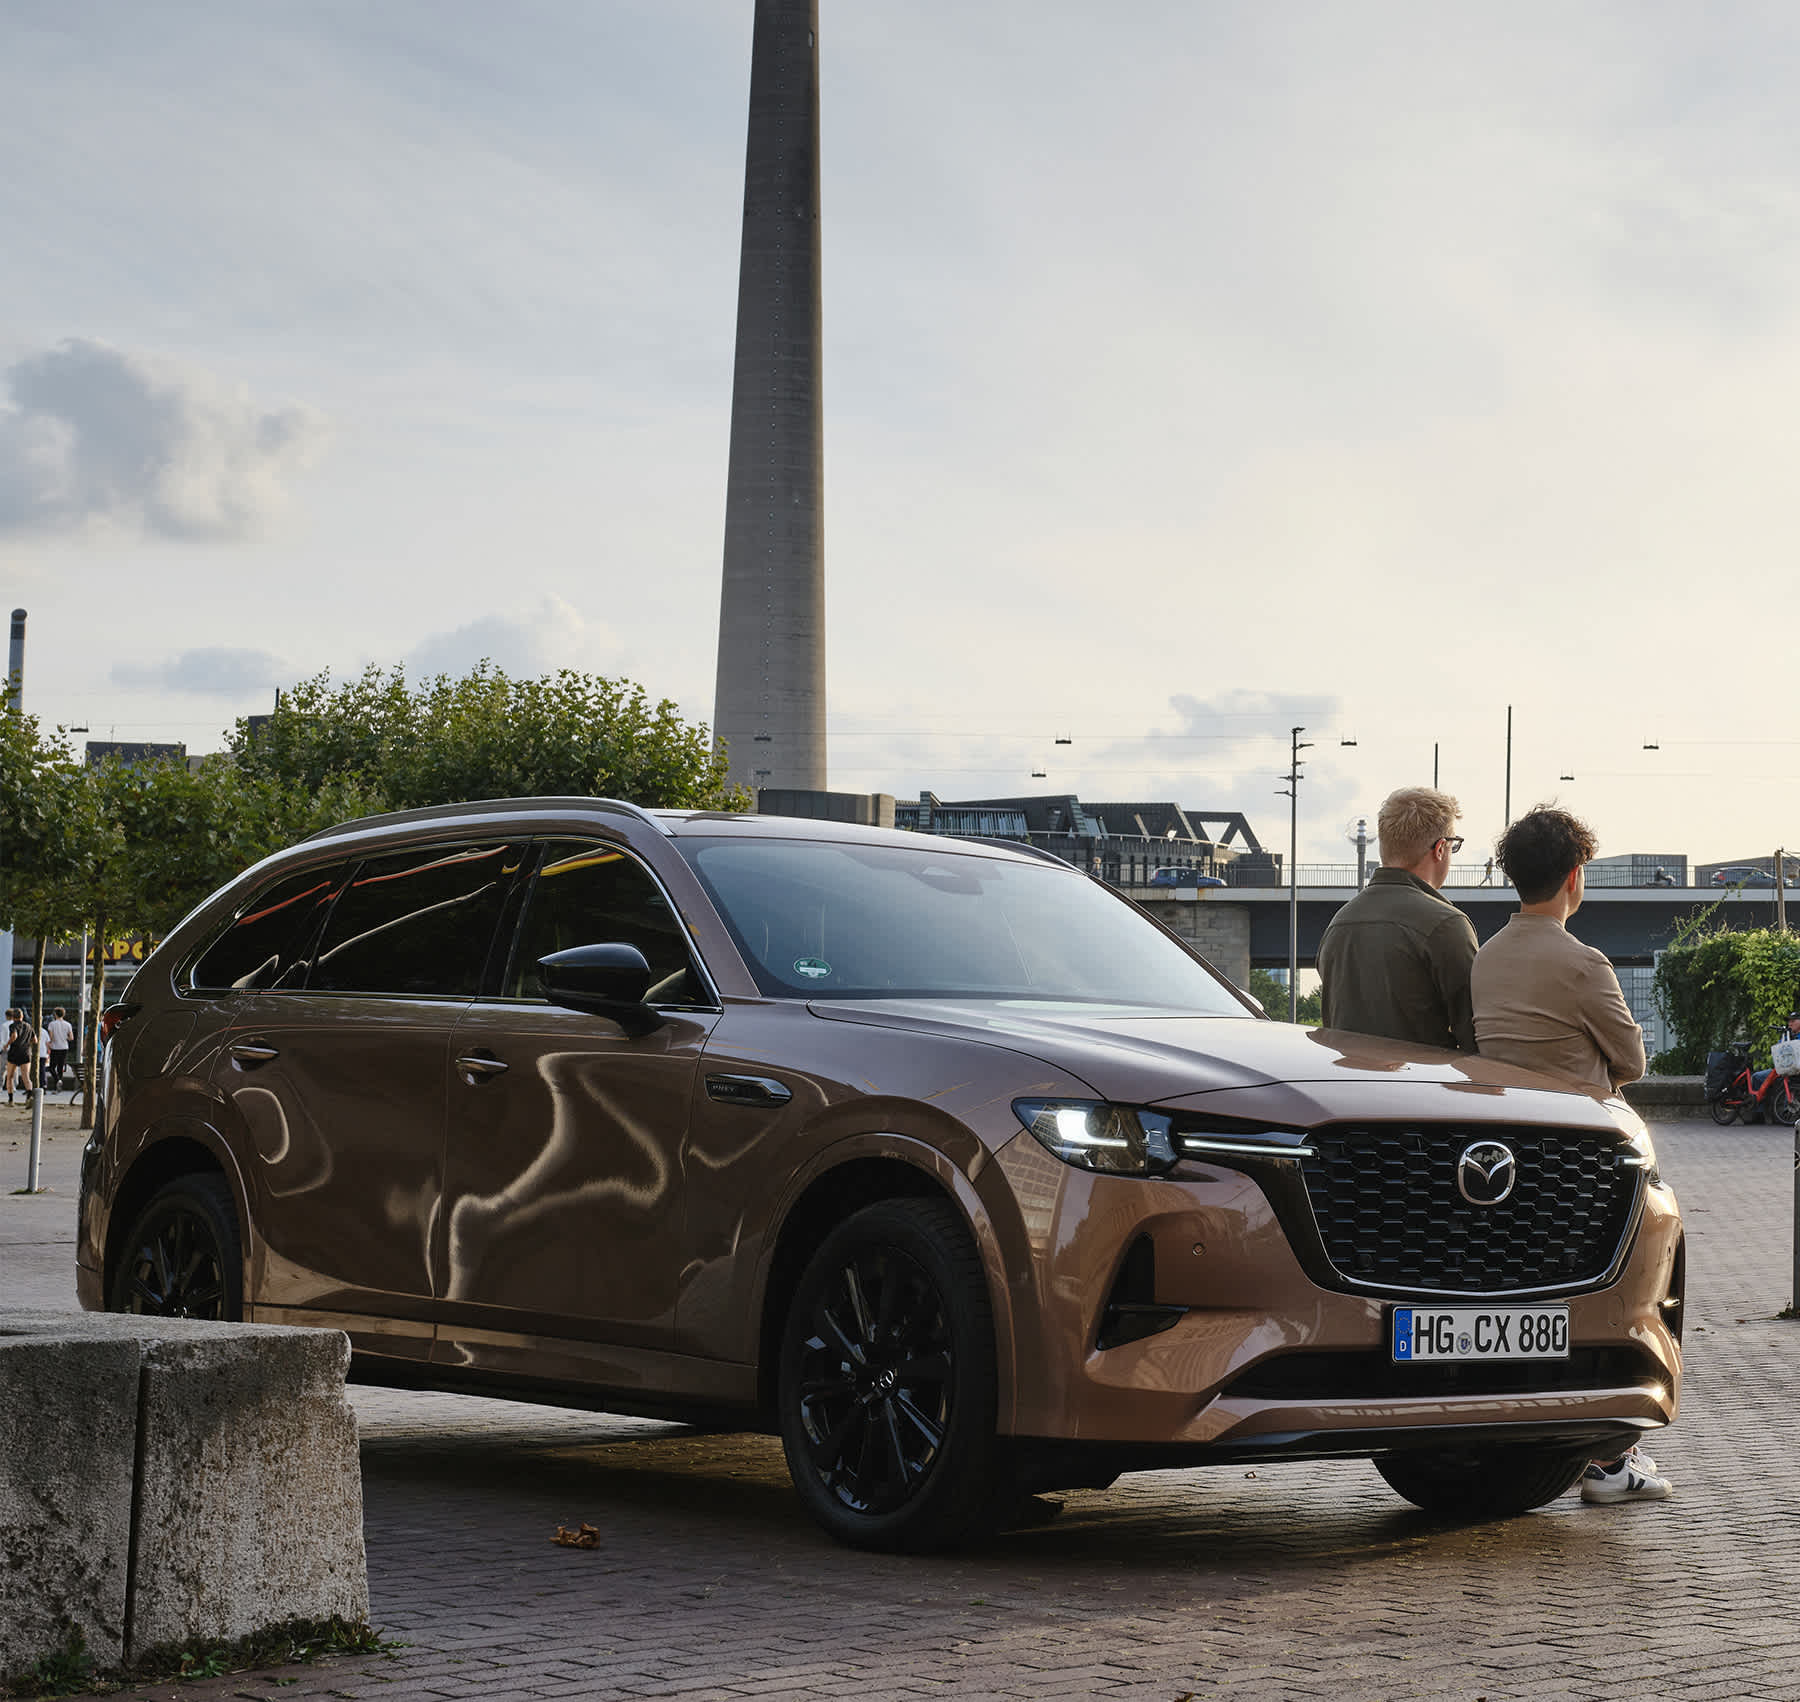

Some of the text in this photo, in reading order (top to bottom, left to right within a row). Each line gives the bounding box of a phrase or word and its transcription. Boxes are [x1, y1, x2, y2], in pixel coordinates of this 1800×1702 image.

[1400, 1340, 1407, 1352] D
[1415, 1314, 1567, 1354] HG CX 880
